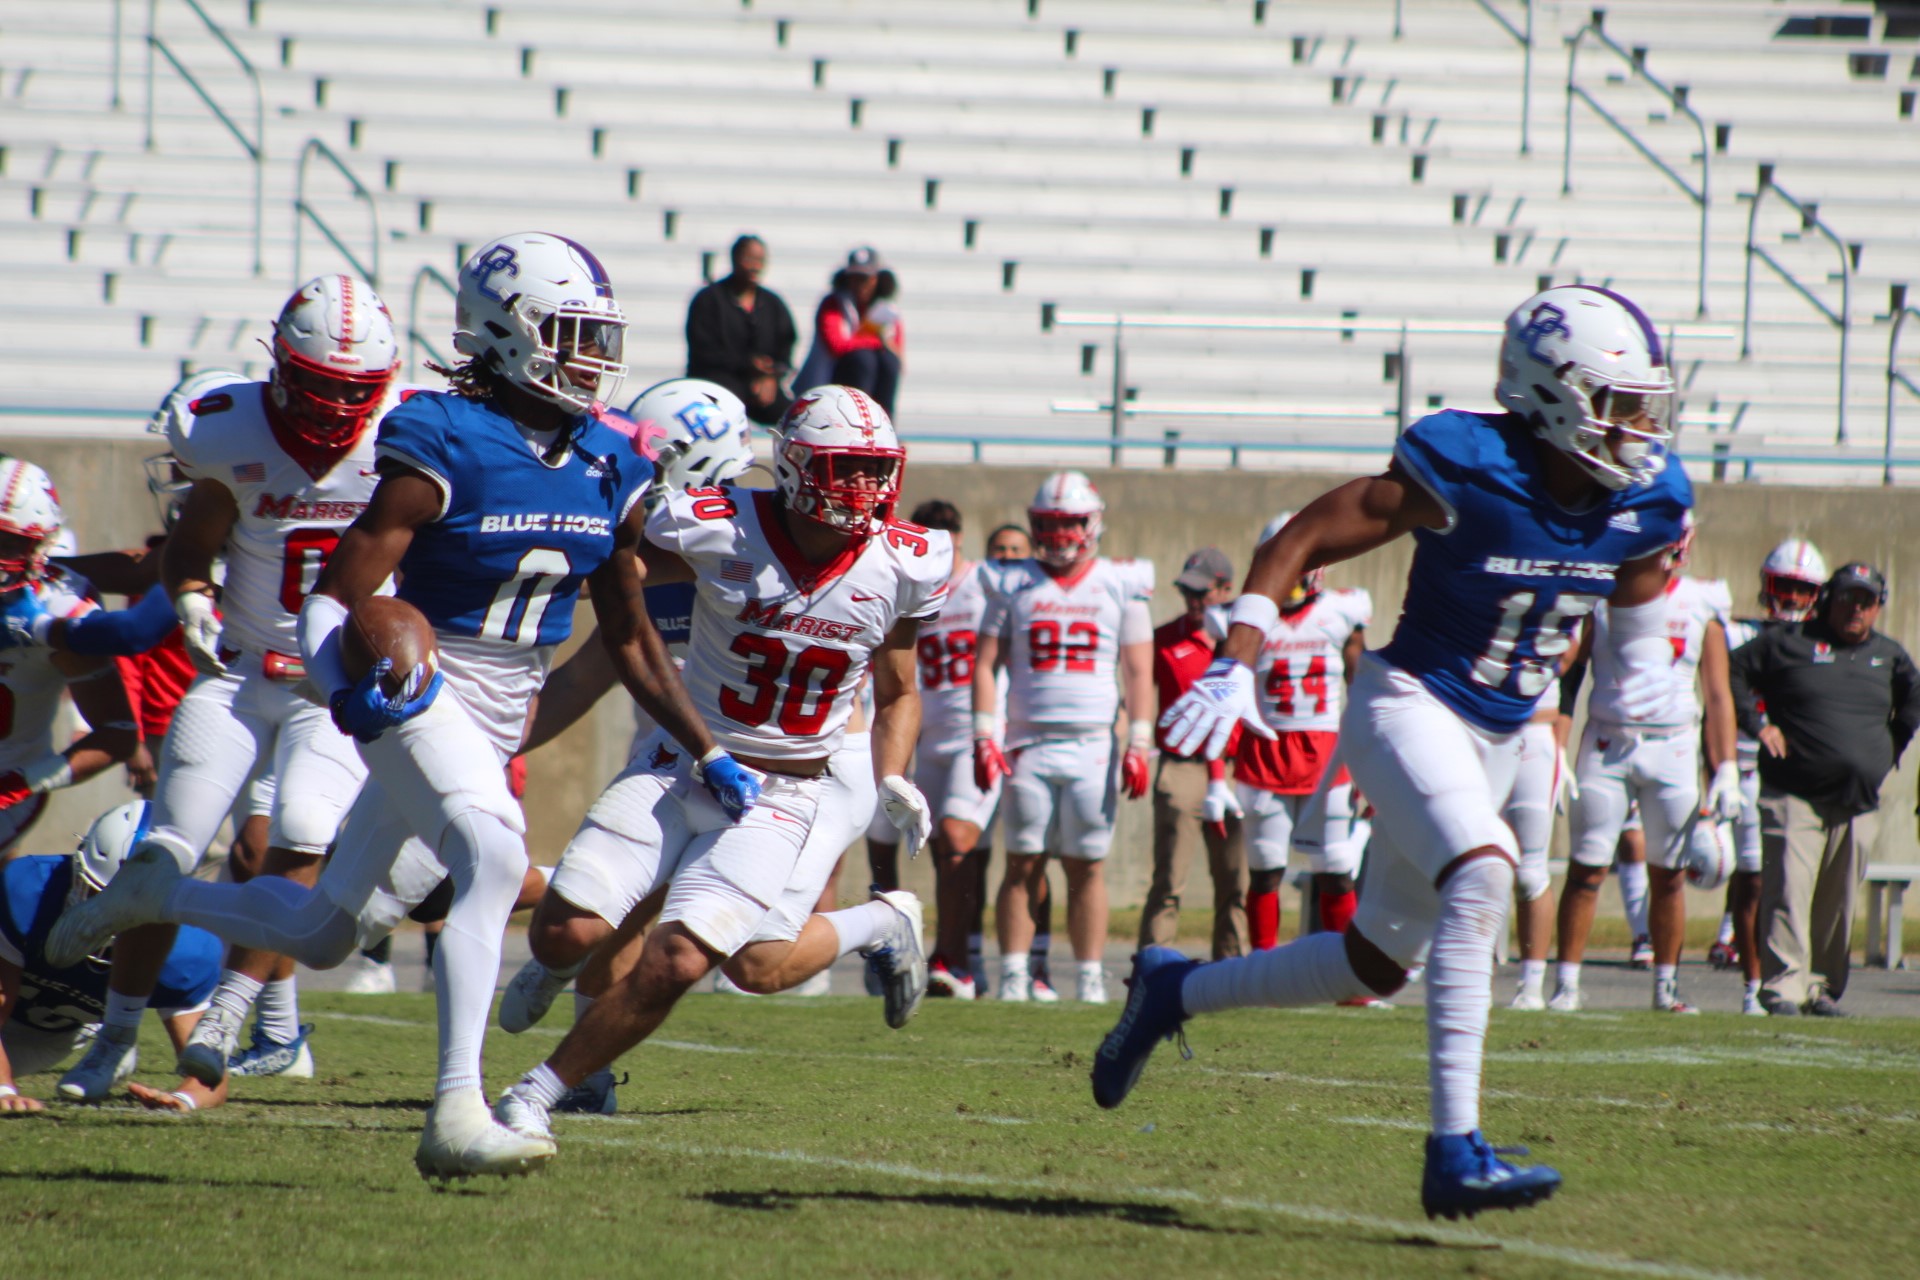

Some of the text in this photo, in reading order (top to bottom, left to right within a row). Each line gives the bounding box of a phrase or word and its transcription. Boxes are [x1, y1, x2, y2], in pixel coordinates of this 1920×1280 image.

[480, 513, 611, 536] BLUE HOSE
[1484, 556, 1560, 576] BLUE
[736, 597, 866, 643] MARIST
[1029, 620, 1100, 674] 92
[719, 631, 851, 735] 30
[918, 629, 977, 690] 98
[1266, 655, 1328, 716] 44
